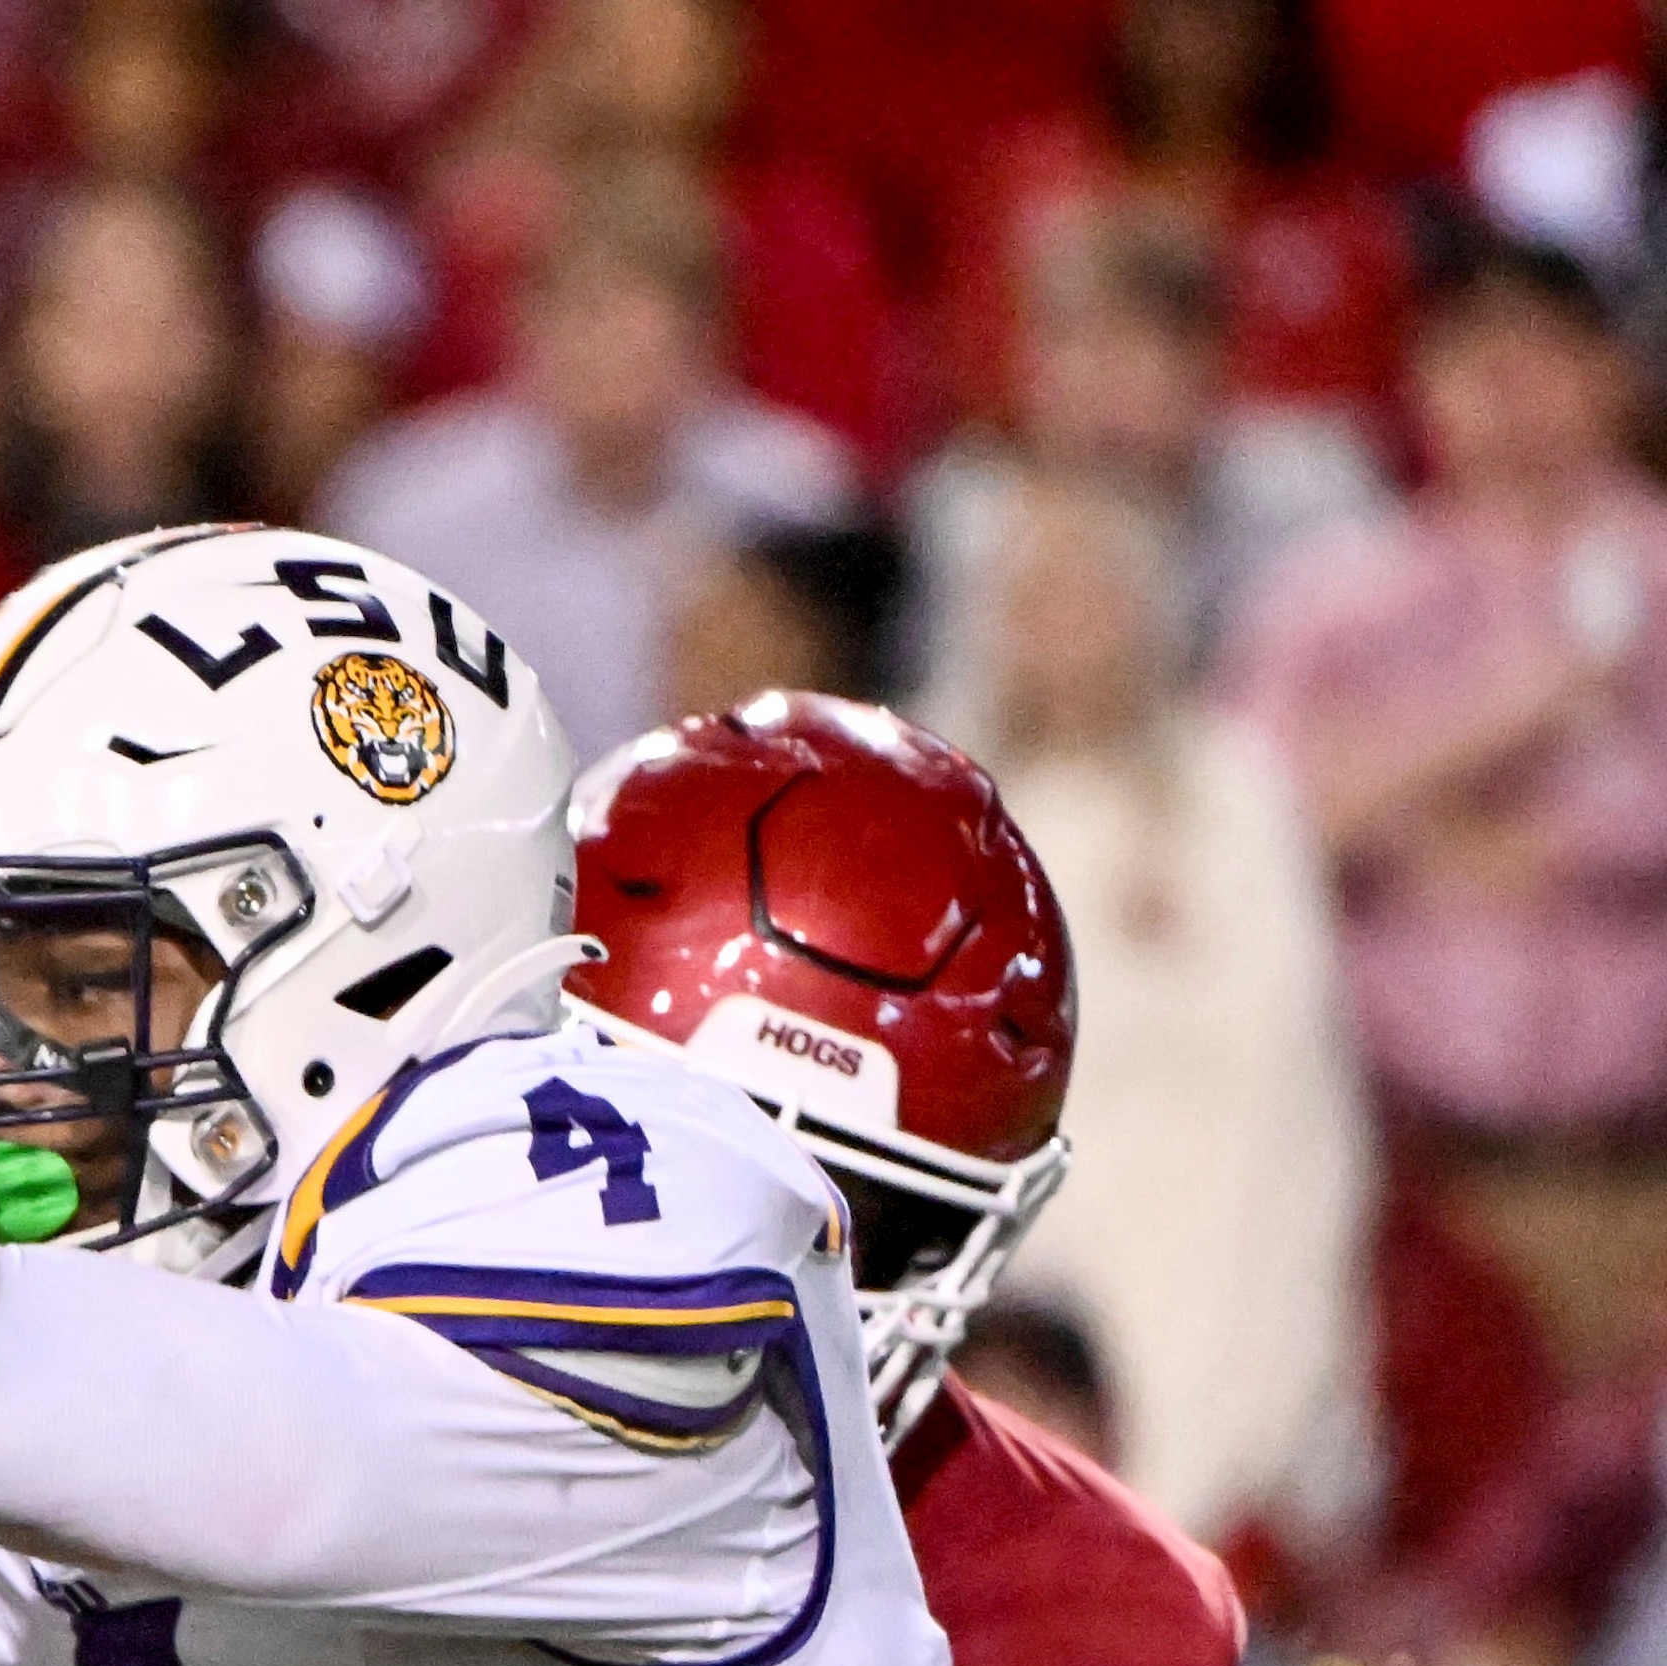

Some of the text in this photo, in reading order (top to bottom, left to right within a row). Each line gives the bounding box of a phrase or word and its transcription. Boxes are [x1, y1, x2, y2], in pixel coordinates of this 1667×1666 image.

[135, 559, 510, 710] LSU
[756, 1018, 864, 1078] HOGS
[520, 1075, 662, 1227] 4
